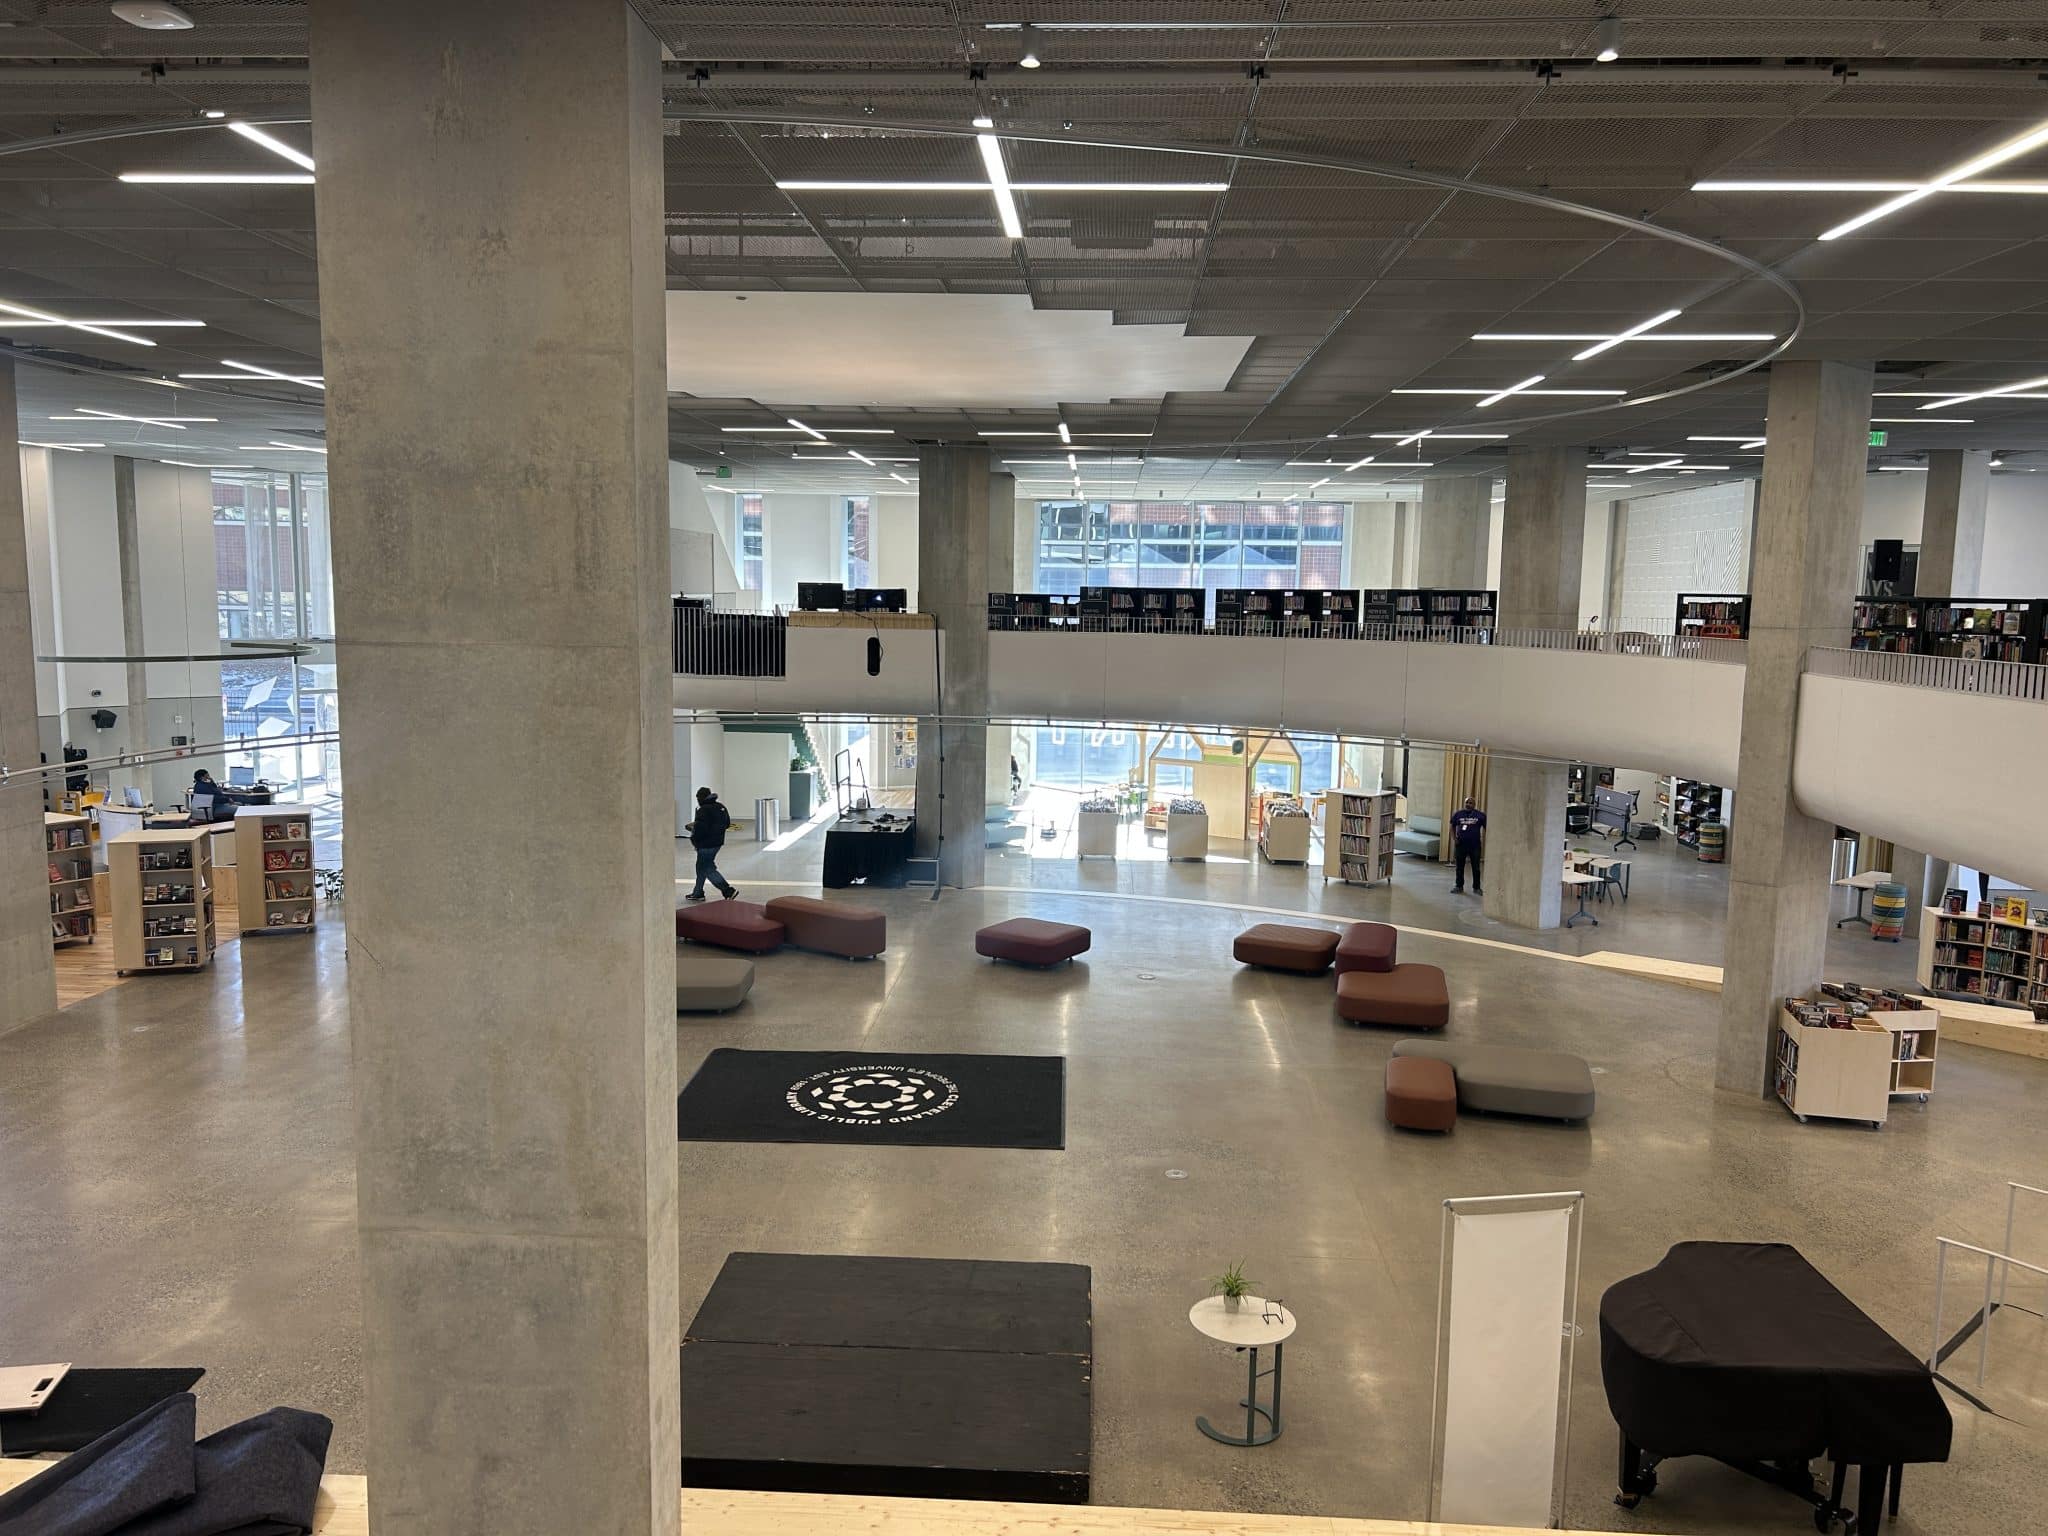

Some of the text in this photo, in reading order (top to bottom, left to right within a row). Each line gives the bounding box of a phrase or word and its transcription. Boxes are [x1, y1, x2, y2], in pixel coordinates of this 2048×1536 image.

[832, 1065, 904, 1075] UNIVERSITY
[785, 1091, 960, 1125] CLEVELAND PUBLIC LIBRARY
